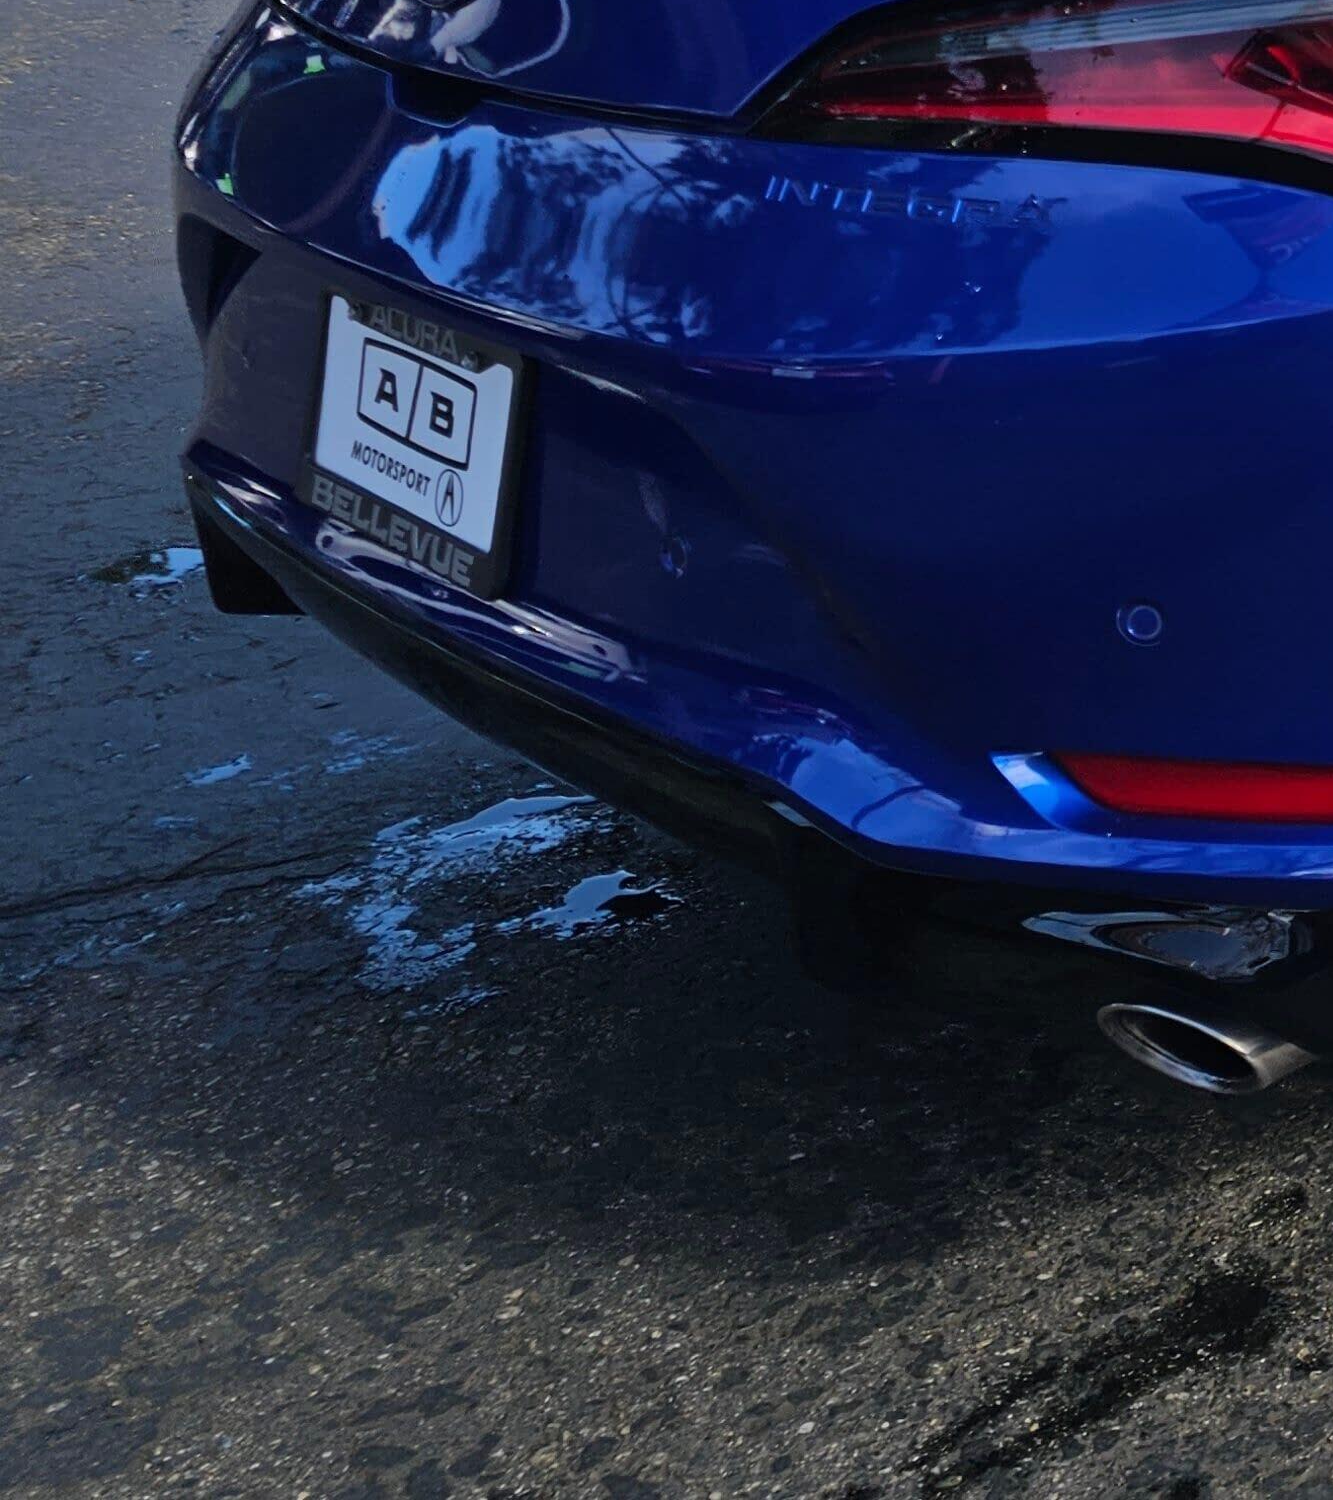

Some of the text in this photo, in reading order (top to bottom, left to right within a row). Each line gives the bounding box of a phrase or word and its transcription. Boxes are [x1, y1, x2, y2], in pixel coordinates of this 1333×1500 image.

[368, 304, 458, 361] ACURA
[374, 367, 455, 439] A B
[350, 439, 432, 497] MOTORSPORT
[310, 475, 475, 588] BELLEVUE
